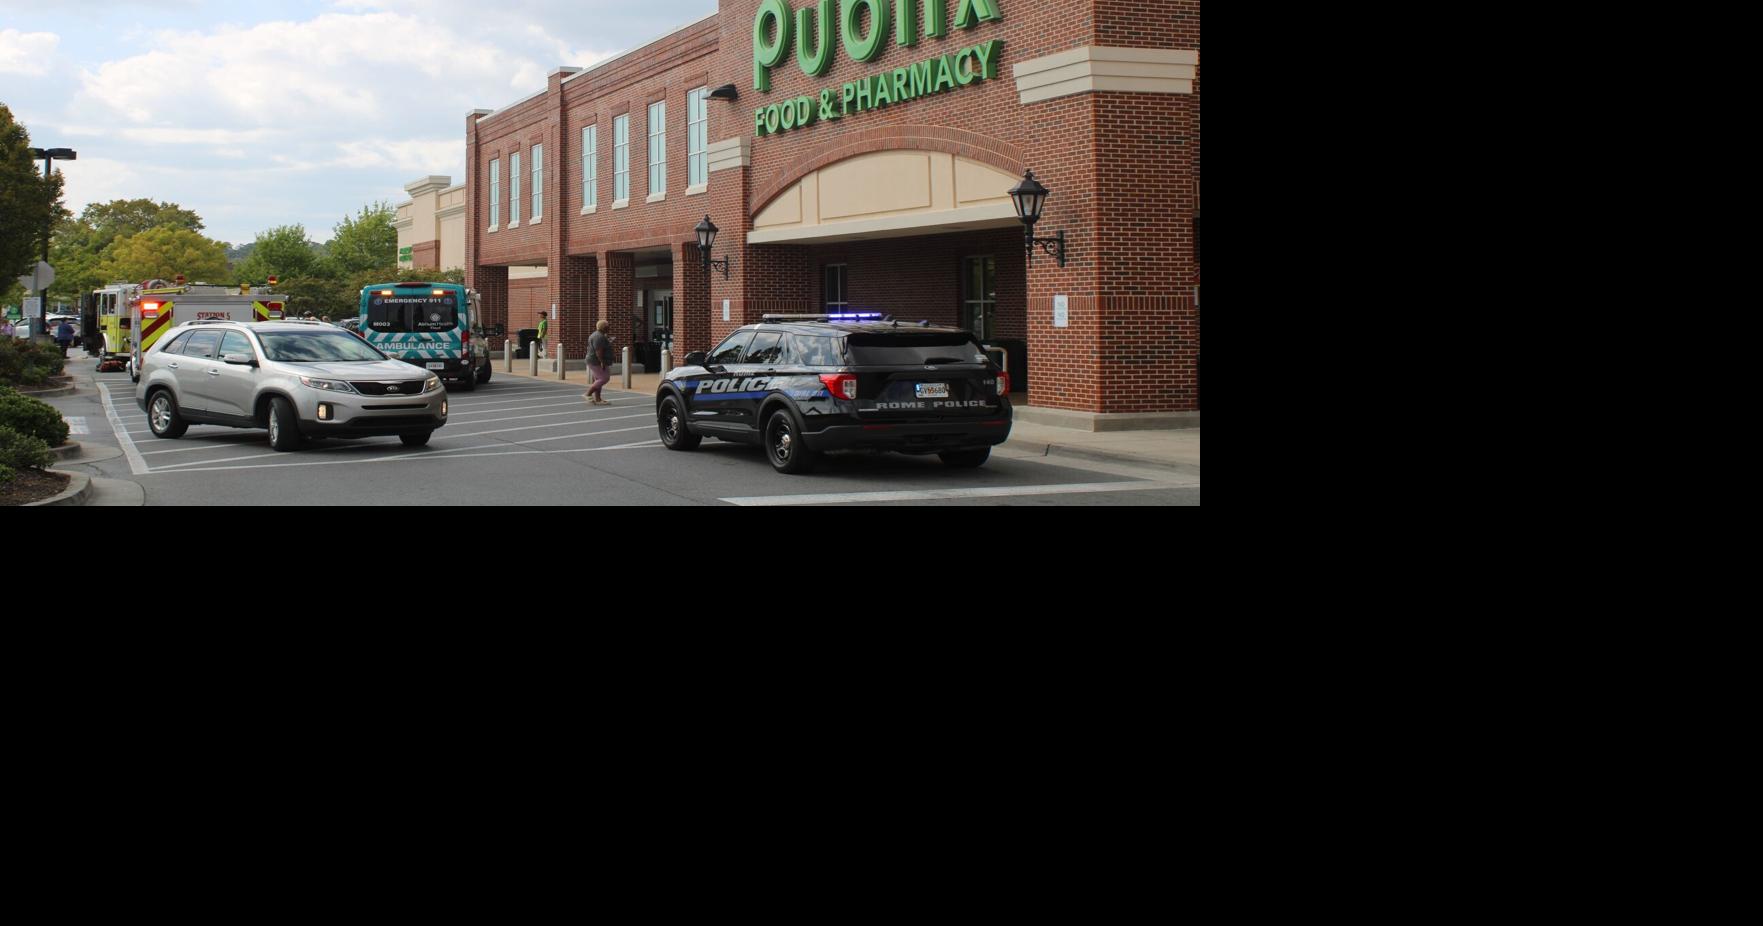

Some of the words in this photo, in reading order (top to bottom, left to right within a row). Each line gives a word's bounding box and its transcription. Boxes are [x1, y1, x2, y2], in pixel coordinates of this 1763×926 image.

[755, 95, 816, 136] FOOD
[819, 88, 838, 120] &
[843, 40, 1002, 114] PHARMACY
[196, 311, 225, 320] STATION
[377, 342, 450, 350] AMBULANCE
[875, 401, 925, 409] ROME
[933, 400, 986, 408] POLICE
